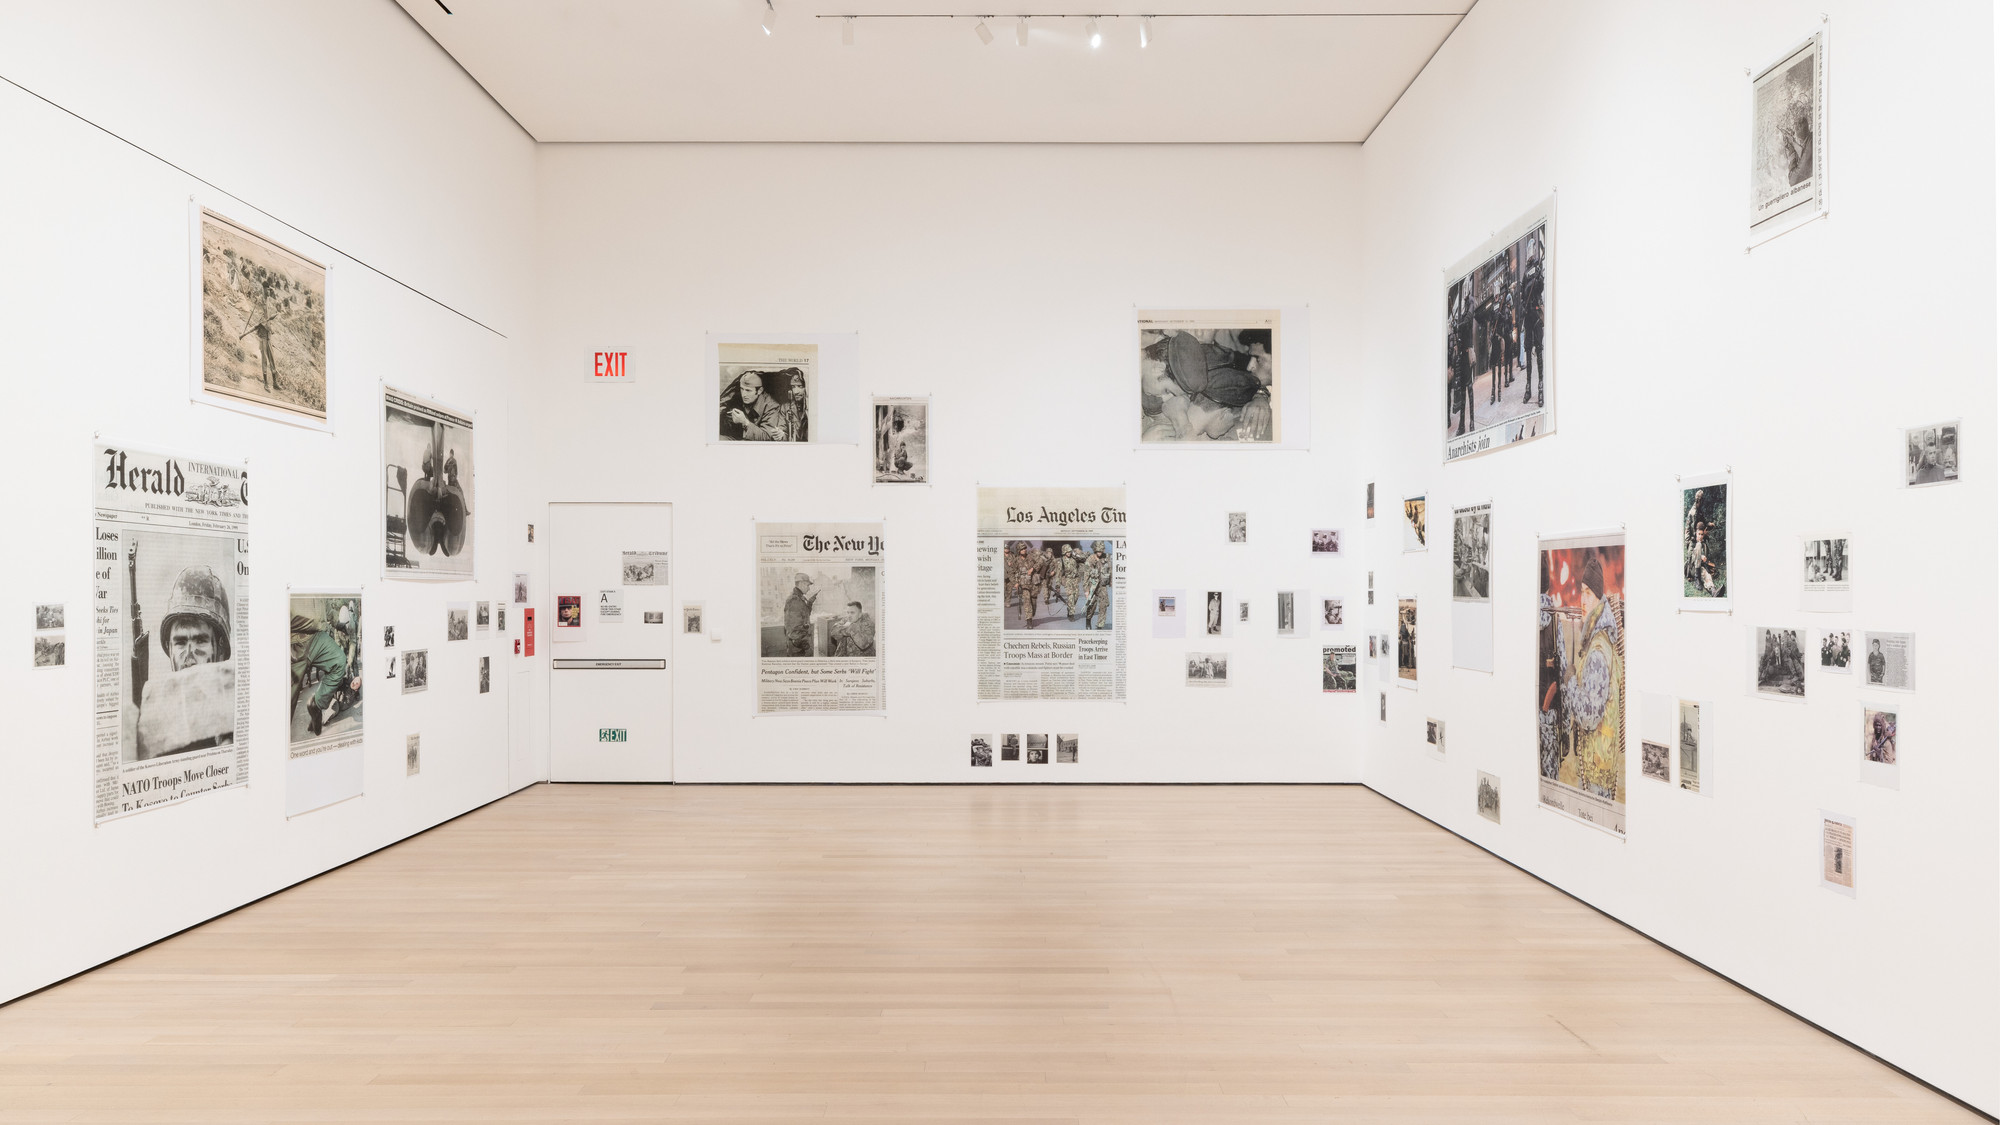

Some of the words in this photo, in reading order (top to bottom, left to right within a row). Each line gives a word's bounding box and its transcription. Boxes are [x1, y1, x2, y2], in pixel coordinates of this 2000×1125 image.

[595, 352, 628, 377] EXIT
[1447, 440, 1477, 460] Anarchists
[1477, 434, 1491, 452] join
[104, 449, 185, 497] Herald
[188, 461, 240, 480] INTERNATIONAL
[145, 502, 171, 511] PUBLISHED
[1006, 506, 1033, 523] Los
[1037, 506, 1096, 526] Angeles
[96, 527, 119, 541] Loses
[803, 534, 831, 554] The
[833, 535, 865, 552] New
[96, 547, 117, 560] illion
[1116, 552, 1127, 560] Pr
[102, 567, 111, 579] of
[1115, 564, 1127, 572] for
[600, 593, 608, 603] A
[104, 627, 118, 636] Japan
[1003, 642, 1029, 650] Chechen
[1030, 642, 1051, 650] Rebels,
[1003, 651, 1026, 660] Troops
[611, 729, 627, 742] EXIT
[290, 751, 298, 759] One
[122, 778, 150, 797] NATO
[152, 776, 182, 790] Troops
[184, 769, 204, 784] Move
[206, 765, 229, 778] Closer
